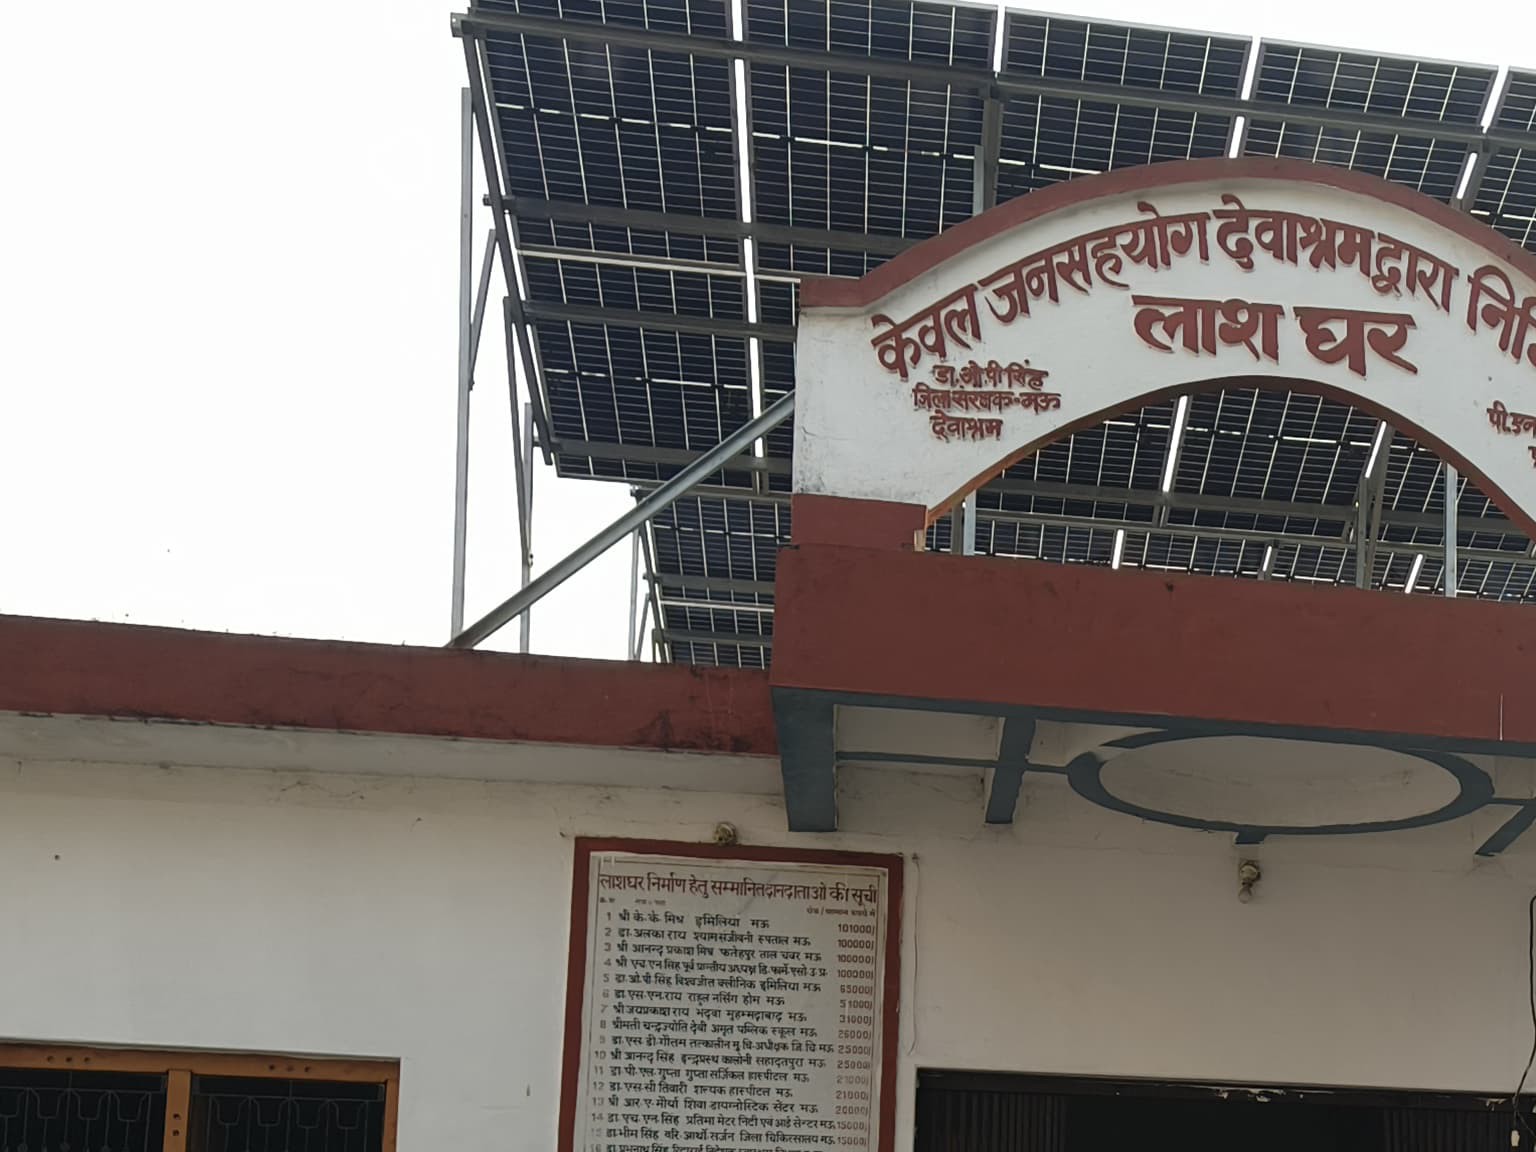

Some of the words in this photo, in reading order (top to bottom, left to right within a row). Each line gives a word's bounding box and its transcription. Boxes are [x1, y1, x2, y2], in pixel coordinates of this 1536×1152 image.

[871, 283, 982, 381] केवल
[978, 201, 1211, 325] जनसहयोग
[1213, 193, 1375, 278] देवाश्रम
[1371, 232, 1460, 315] द्वारा
[1132, 295, 1285, 364] लाश
[1293, 306, 1418, 378] घर
[1003, 359, 1048, 391] सिंह
[929, 409, 1003, 443] देवाश्रम
[647, 872, 687, 893] निर्माण
[689, 874, 709, 899] हेतु
[829, 882, 849, 902] की
[851, 884, 877, 905] सूची
[619, 909, 630, 921] श्री
[695, 914, 740, 929] इमिलिया
[750, 919, 769, 929] मऊ
[605, 928, 611, 937] 2
[668, 931, 687, 941] राय
[793, 937, 811, 947] मऊ
[603, 973, 609, 983] 5
[803, 983, 821, 992] मऊ
[742, 992, 760, 1005] होम
[766, 996, 784, 1006] मऊ
[613, 1002, 624, 1015] श्री
[673, 1007, 689, 1017] राय
[788, 1012, 806, 1022] मऊ
[612, 1017, 640, 1030] श्रीमती
[690, 1020, 707, 1035] देवी
[711, 1023, 734, 1037] अमृत
[800, 1028, 817, 1038] मऊ
[611, 1048, 622, 1060] श्री
[624, 1052, 654, 1064] आनन्द
[756, 1056, 804, 1070] सहादतपुरा
[808, 1059, 826, 1069] मऊ
